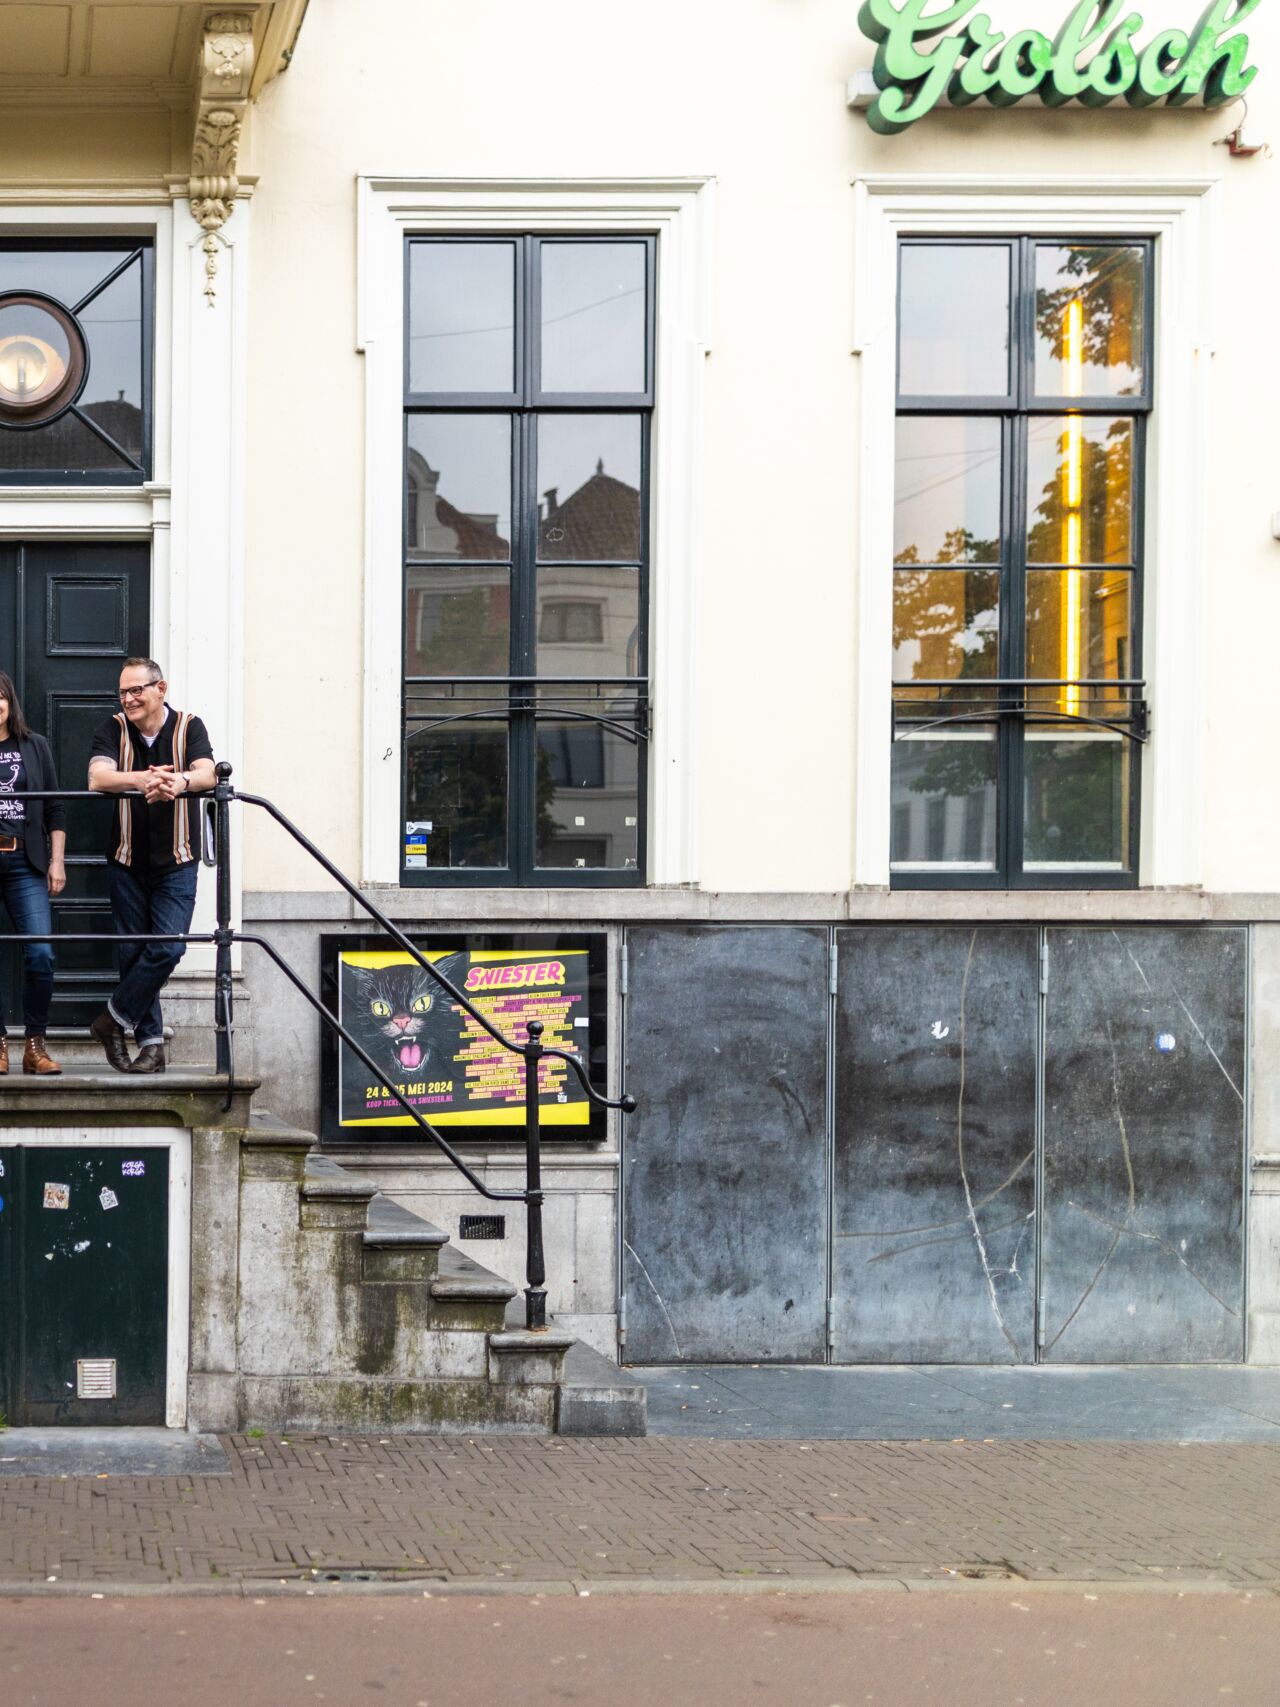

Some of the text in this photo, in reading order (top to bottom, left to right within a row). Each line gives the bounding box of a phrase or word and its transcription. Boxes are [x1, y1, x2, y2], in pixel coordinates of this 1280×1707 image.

[868, 0, 1259, 124] Grolsch
[465, 961, 564, 990] SNIESTER
[366, 1086, 379, 1099] 24
[381, 1086, 390, 1097] &
[407, 1083, 426, 1096] MEI
[428, 1081, 454, 1094] 2024
[366, 1100, 382, 1108] KOOP
[418, 1094, 454, 1105] SNIESTER.NL
